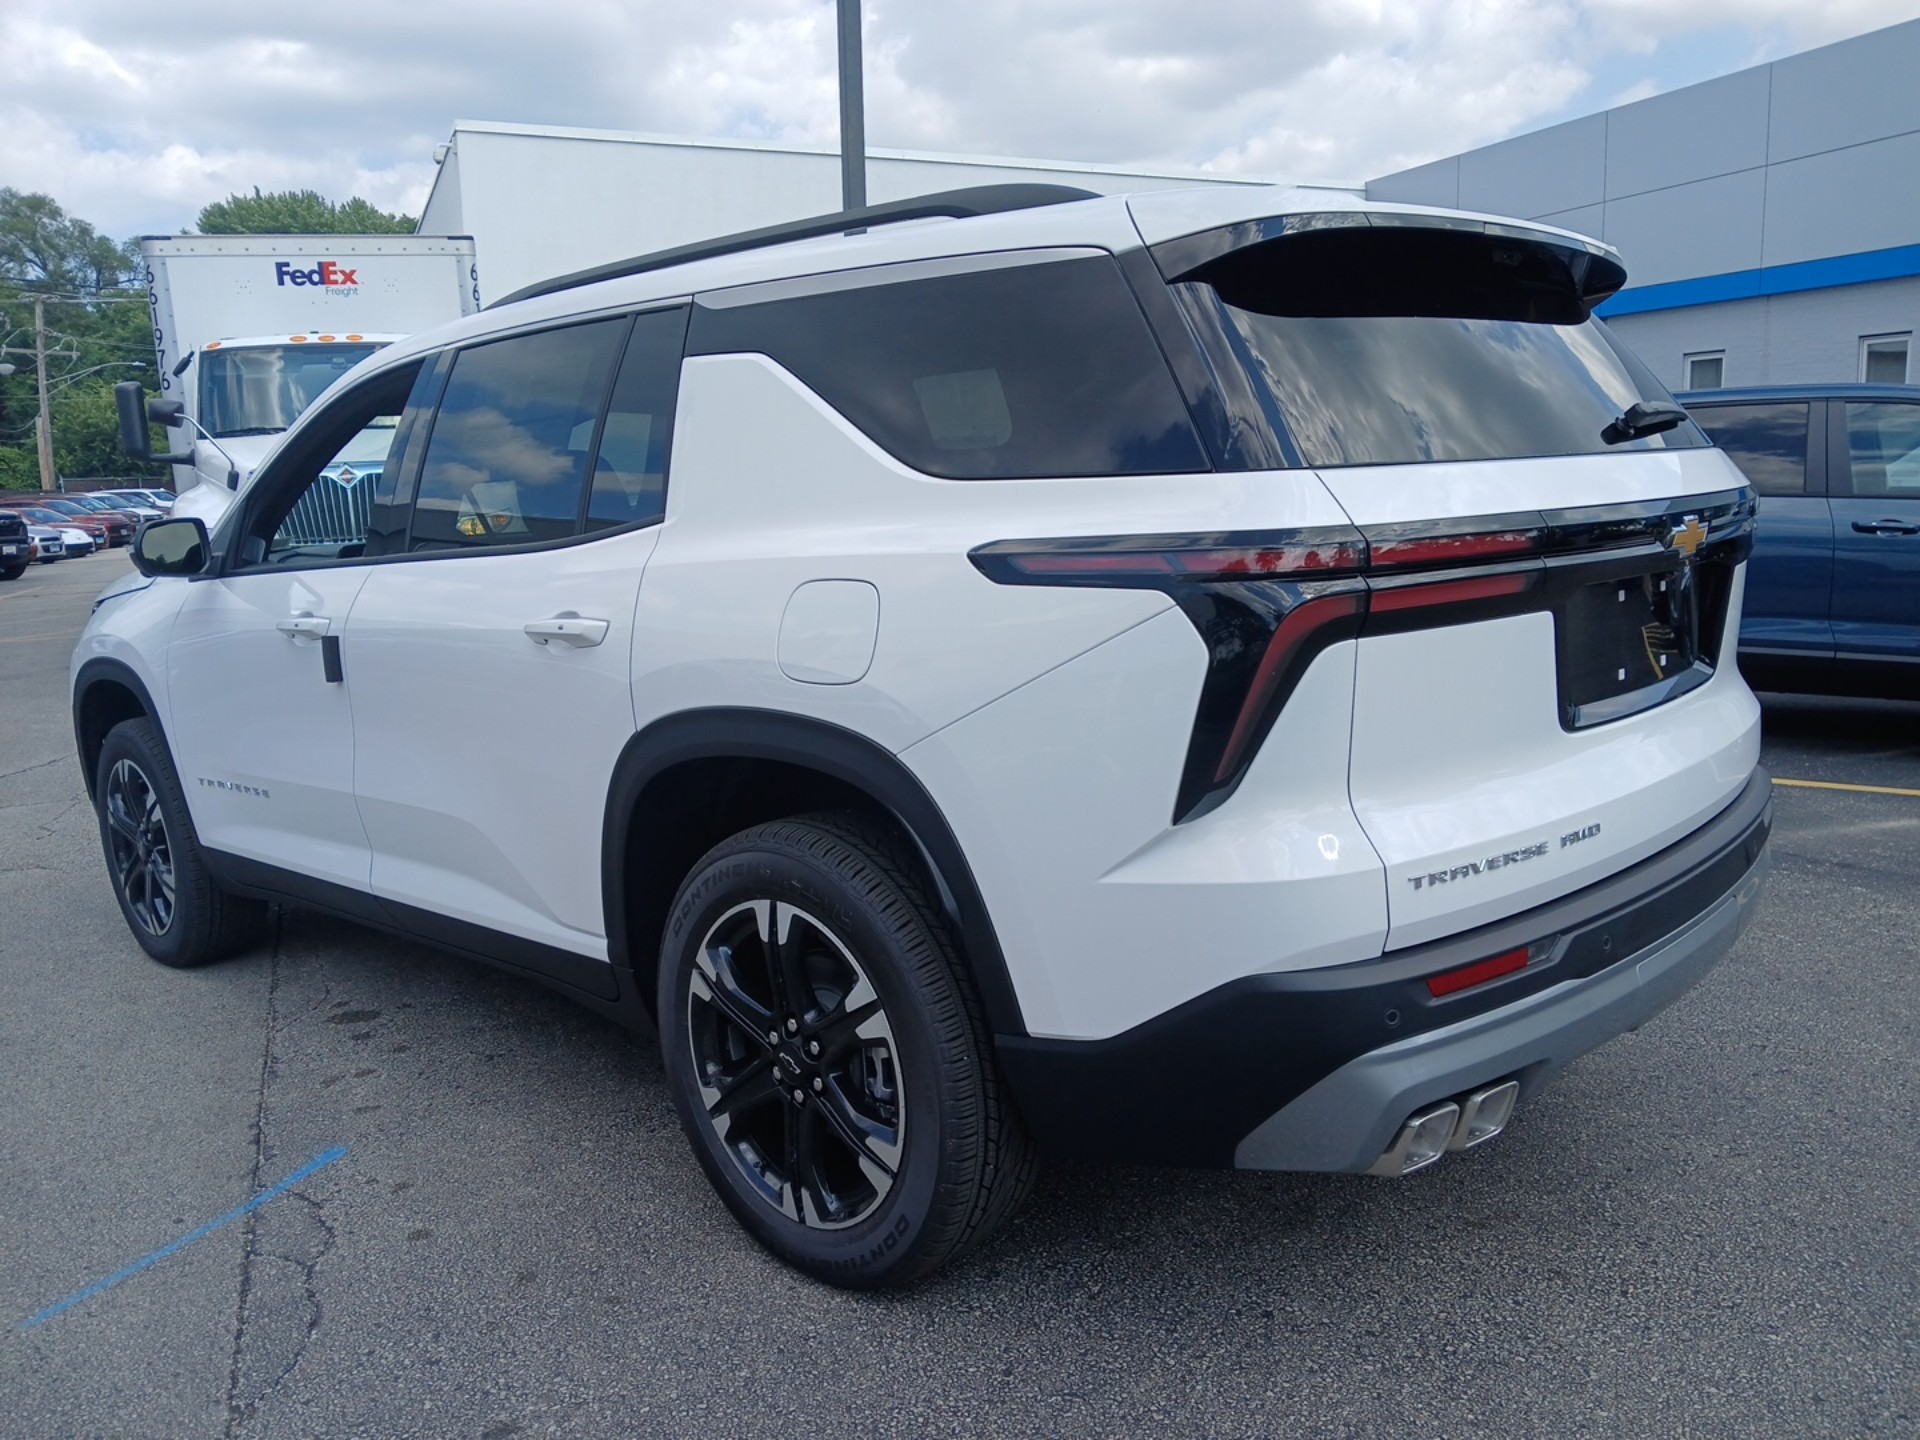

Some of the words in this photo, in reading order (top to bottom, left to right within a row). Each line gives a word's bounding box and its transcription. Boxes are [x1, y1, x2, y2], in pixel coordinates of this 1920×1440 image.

[275, 261, 359, 287] FedEx
[325, 286, 359, 298] Freight
[146, 264, 171, 391] 661976
[198, 777, 271, 799] TRAVERSE
[1407, 841, 1550, 890] TRAVERSE
[1560, 823, 1601, 849] AWD
[673, 860, 766, 939] CONTINEN
